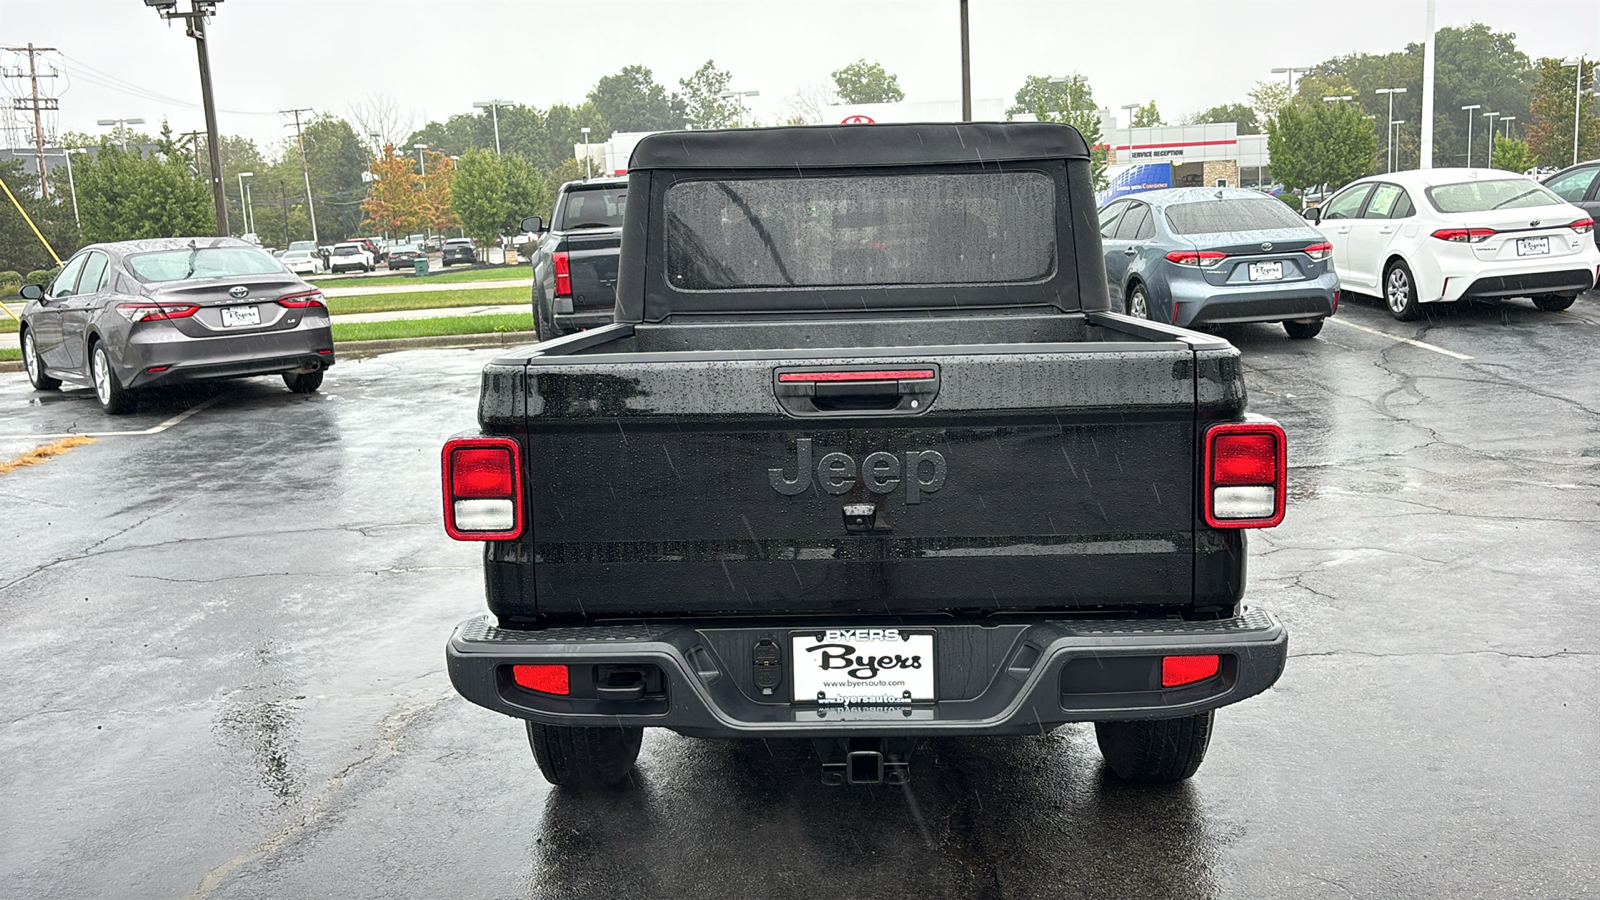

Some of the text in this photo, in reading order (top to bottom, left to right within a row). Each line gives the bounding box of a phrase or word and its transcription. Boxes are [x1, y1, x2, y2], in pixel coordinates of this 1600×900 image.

[1153, 149, 1183, 157] RECEPTION
[767, 437, 948, 505] Jeep
[825, 629, 900, 642] BYERS
[805, 643, 922, 680] Byers
[823, 679, 906, 688] www.byersauto.com
